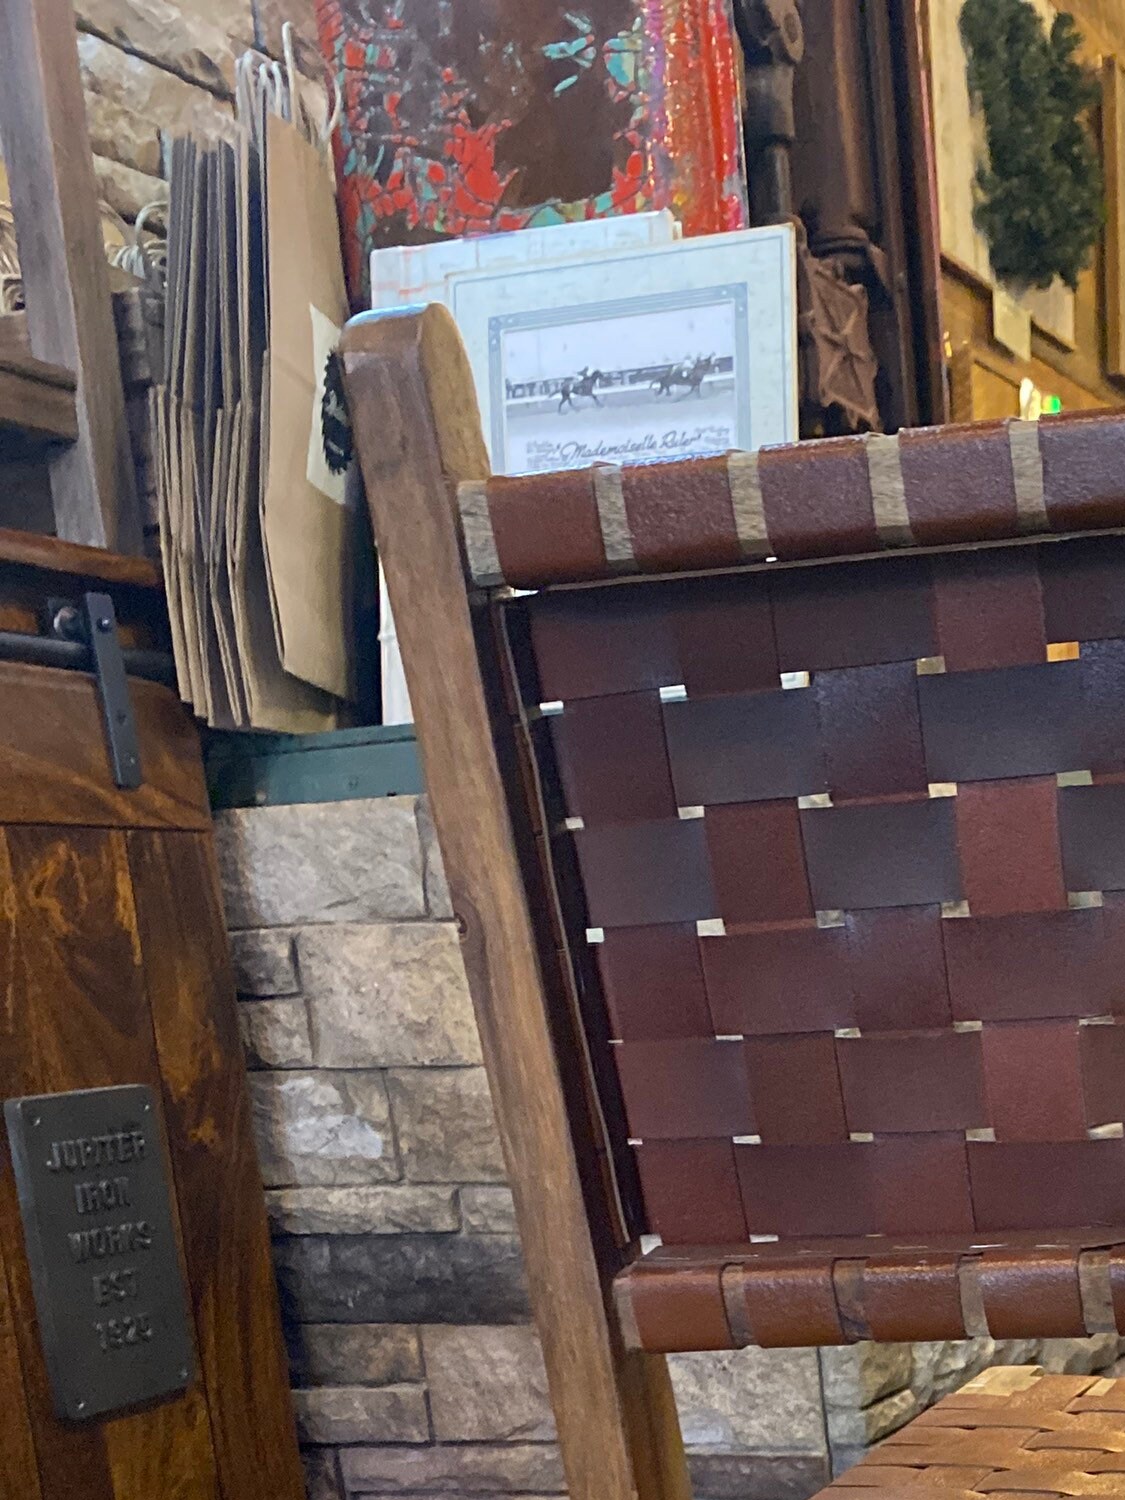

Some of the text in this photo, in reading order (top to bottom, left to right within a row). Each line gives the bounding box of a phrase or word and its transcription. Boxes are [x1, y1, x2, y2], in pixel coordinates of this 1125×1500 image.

[46, 1131, 145, 1169] JUPITER
[75, 1177, 130, 1213] IRON
[67, 1221, 152, 1258] WORKS
